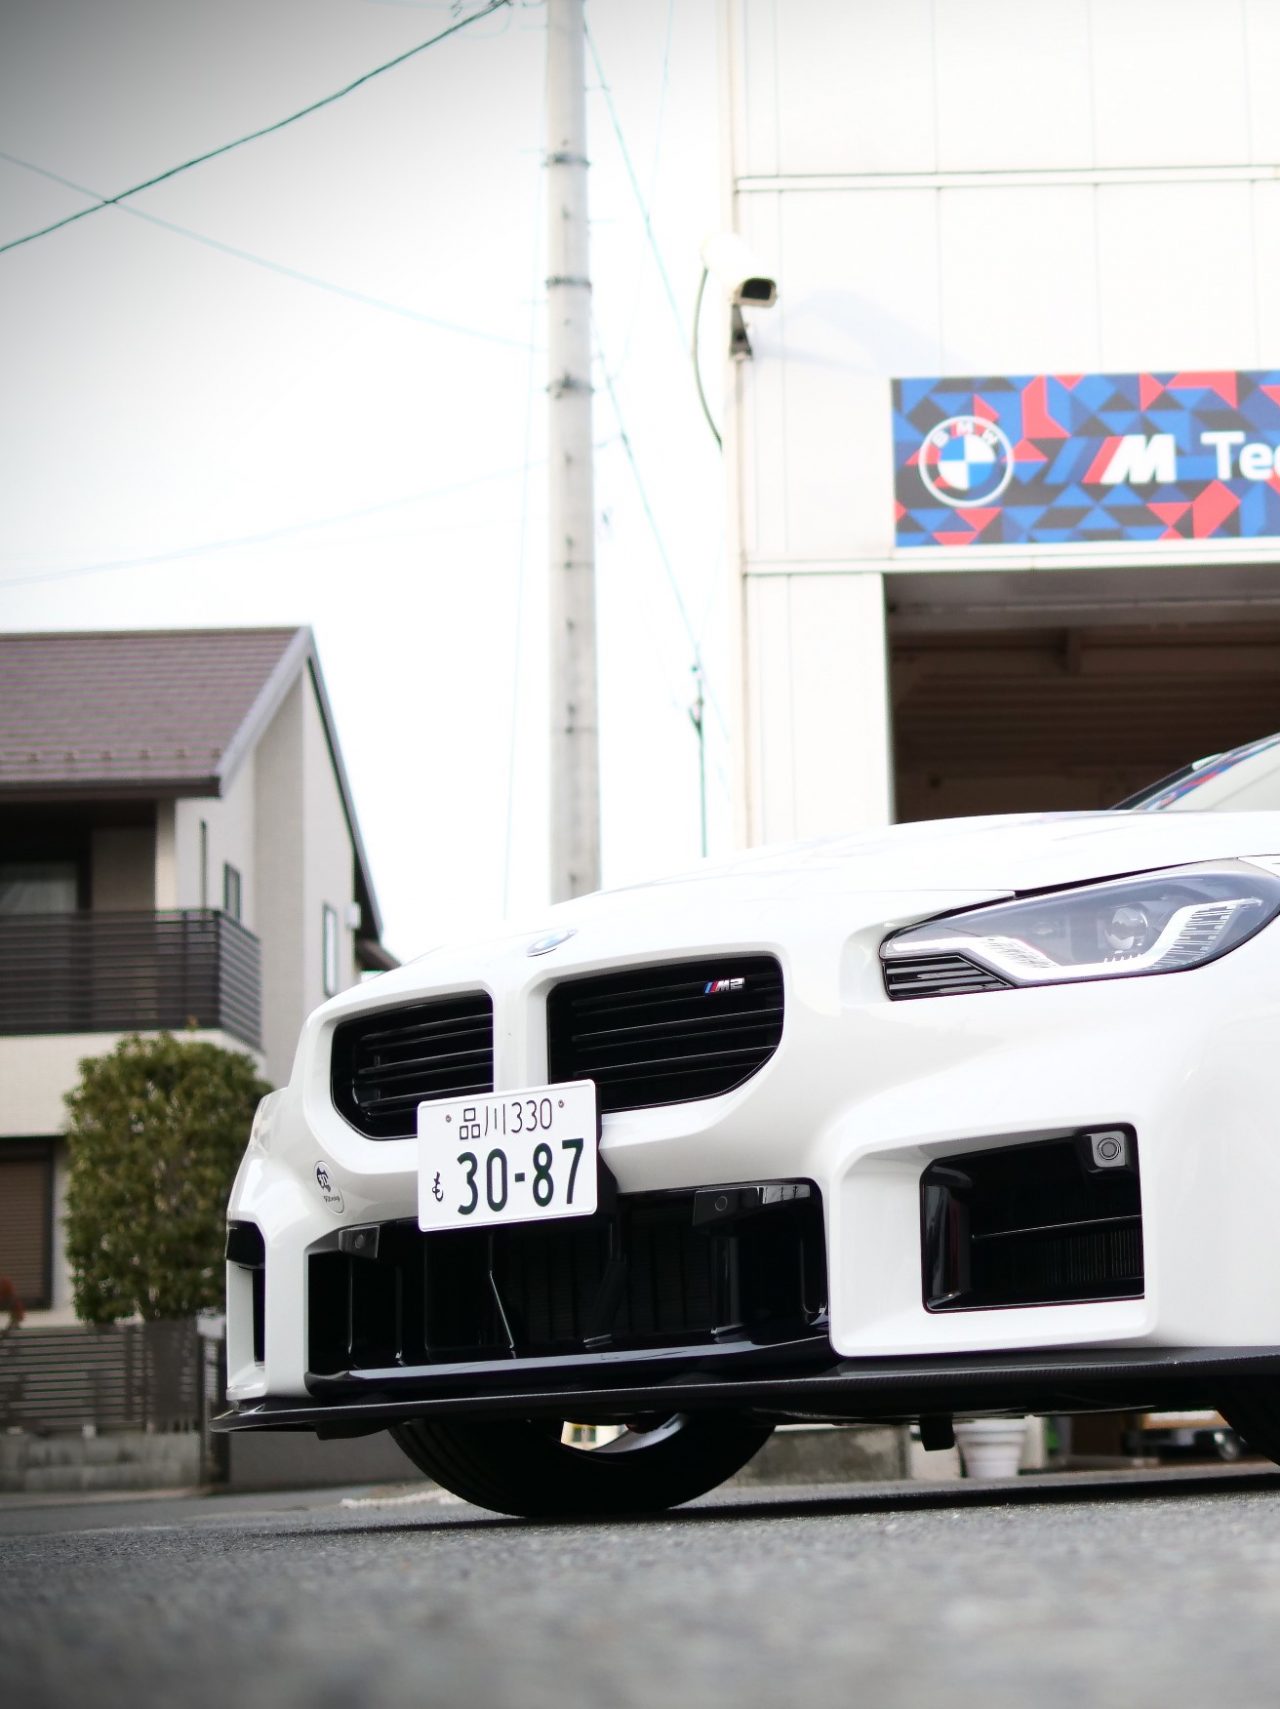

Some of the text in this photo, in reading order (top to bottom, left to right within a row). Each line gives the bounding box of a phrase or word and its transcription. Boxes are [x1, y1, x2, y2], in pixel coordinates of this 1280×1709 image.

[929, 419, 1000, 449] BMW
[1100, 434, 1177, 484] M
[715, 977, 745, 992] M2
[431, 1137, 585, 1216] も 30-87
